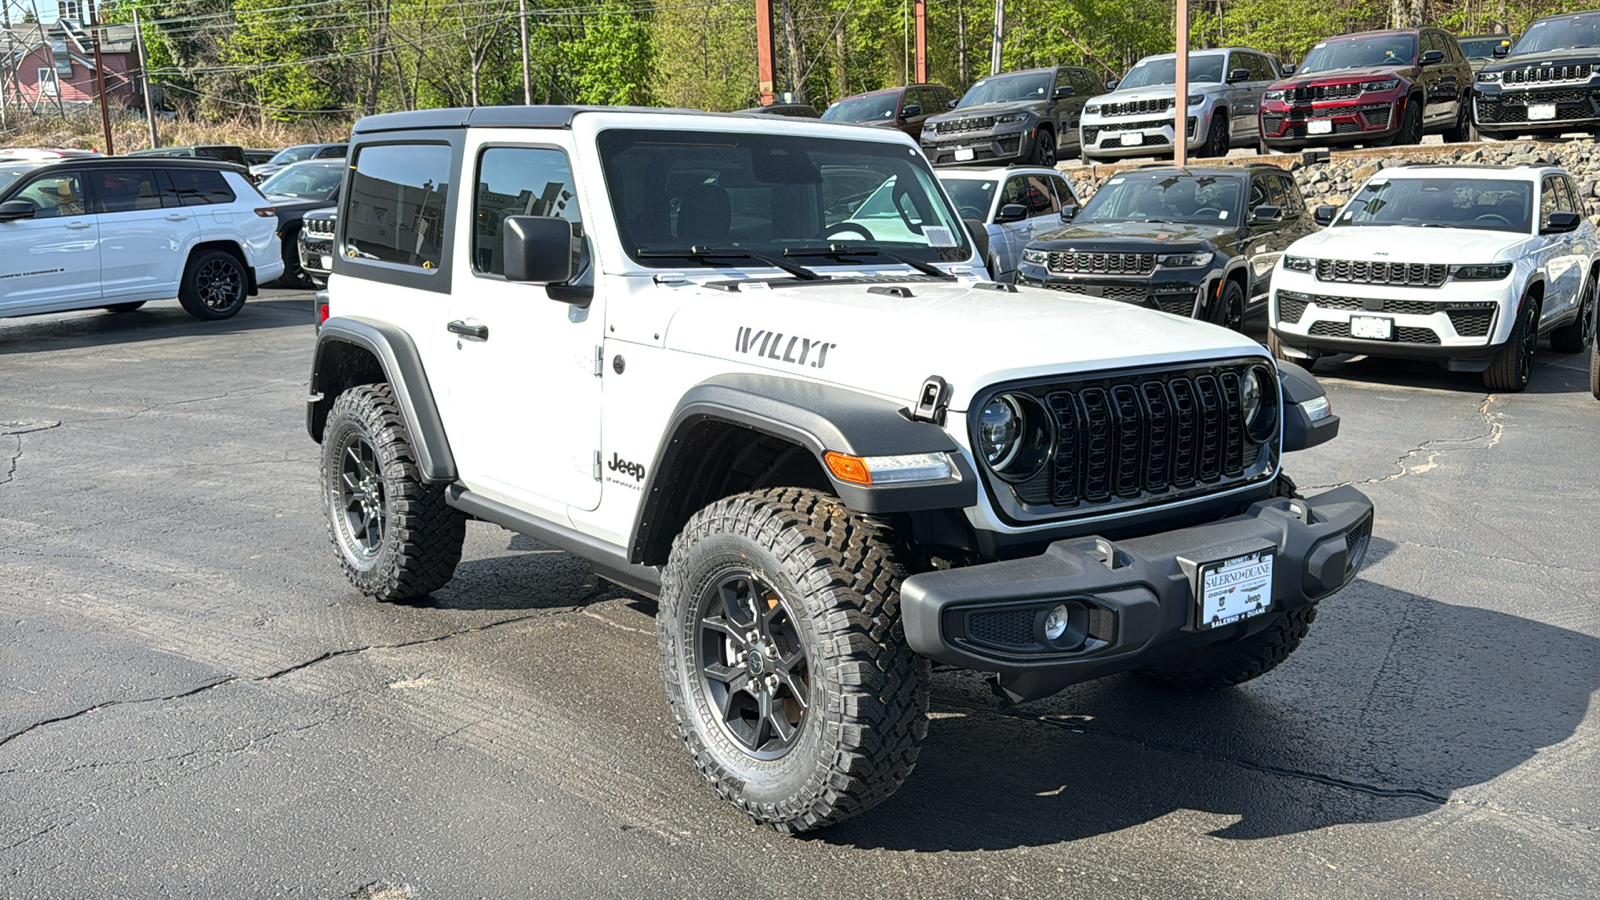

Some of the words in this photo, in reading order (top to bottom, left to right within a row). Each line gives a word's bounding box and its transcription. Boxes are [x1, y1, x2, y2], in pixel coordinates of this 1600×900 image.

[735, 326, 837, 369] WILLYS
[607, 451, 646, 482] Jeep
[1206, 571, 1241, 588] SALERNO
[1245, 563, 1270, 580] DUANE
[1244, 593, 1261, 604] Jeep
[1211, 615, 1239, 628] SALERNO
[1247, 607, 1266, 617] DUANE
